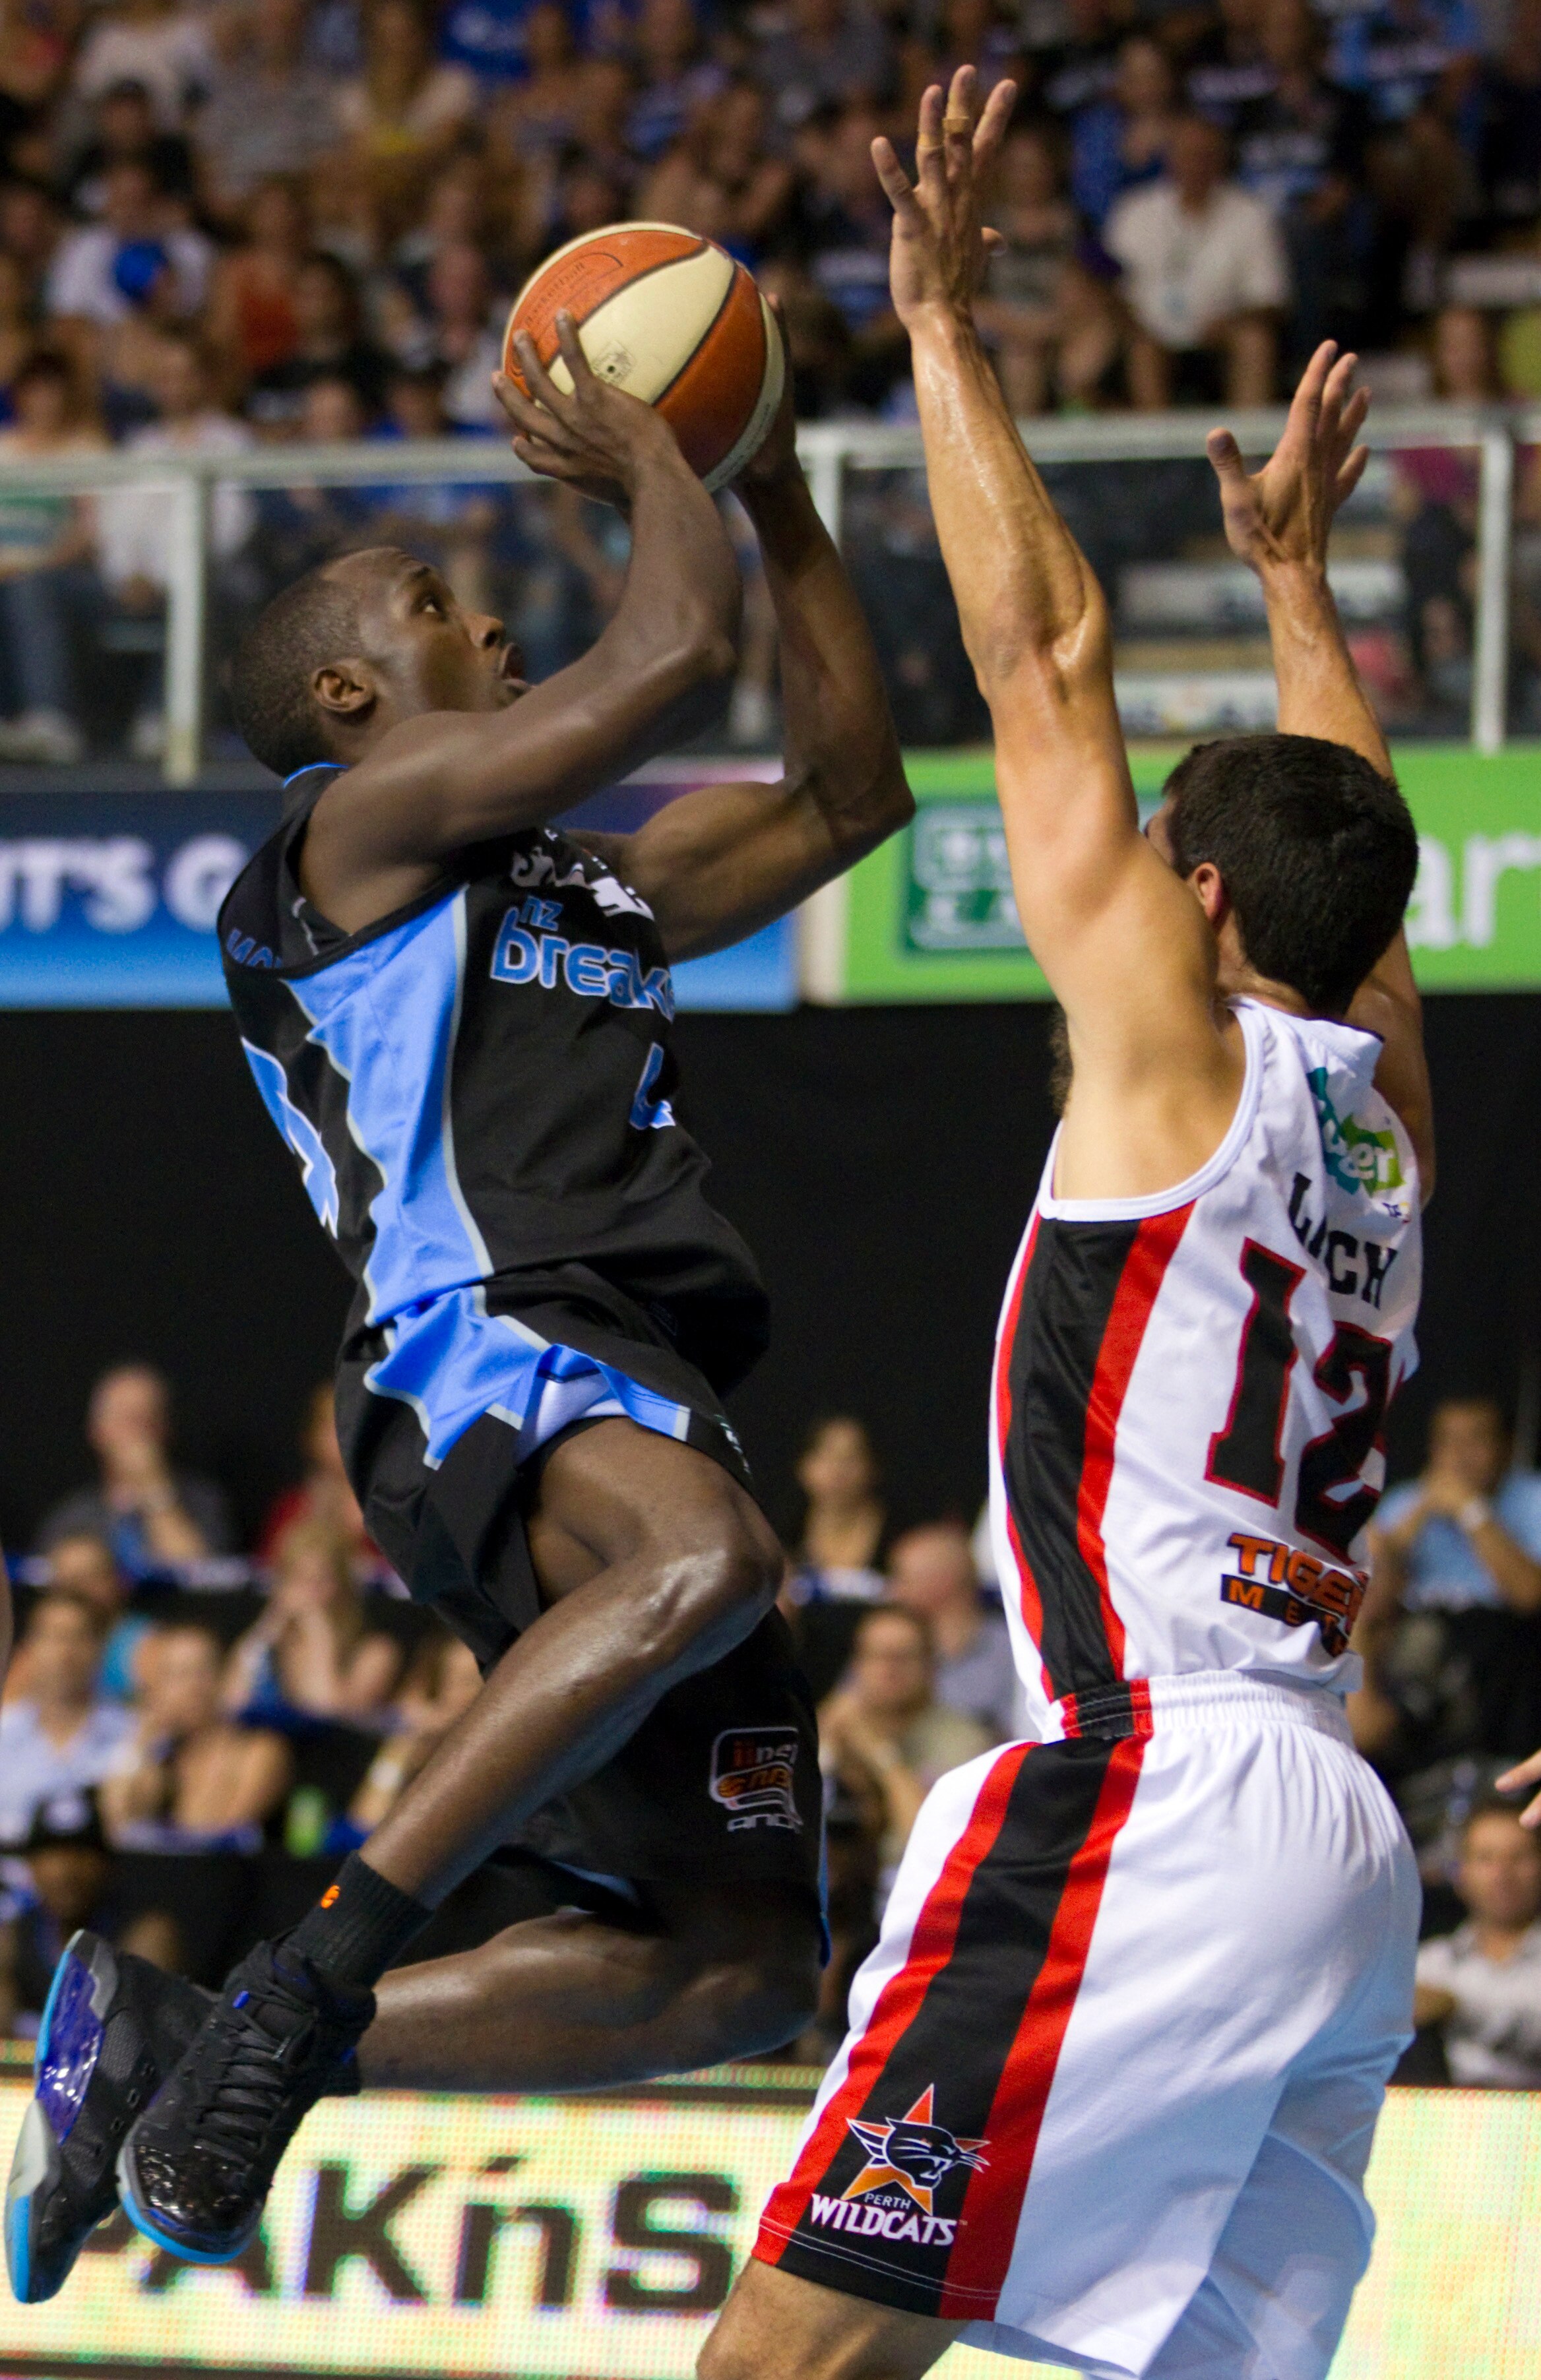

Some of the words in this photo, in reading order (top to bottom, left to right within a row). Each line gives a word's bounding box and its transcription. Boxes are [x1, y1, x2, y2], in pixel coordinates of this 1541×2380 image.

[519, 895, 564, 931] nz
[1203, 1236, 1394, 1566] 12
[811, 2193, 957, 2247] WILDCATS
[864, 2193, 912, 2210] PERTH
